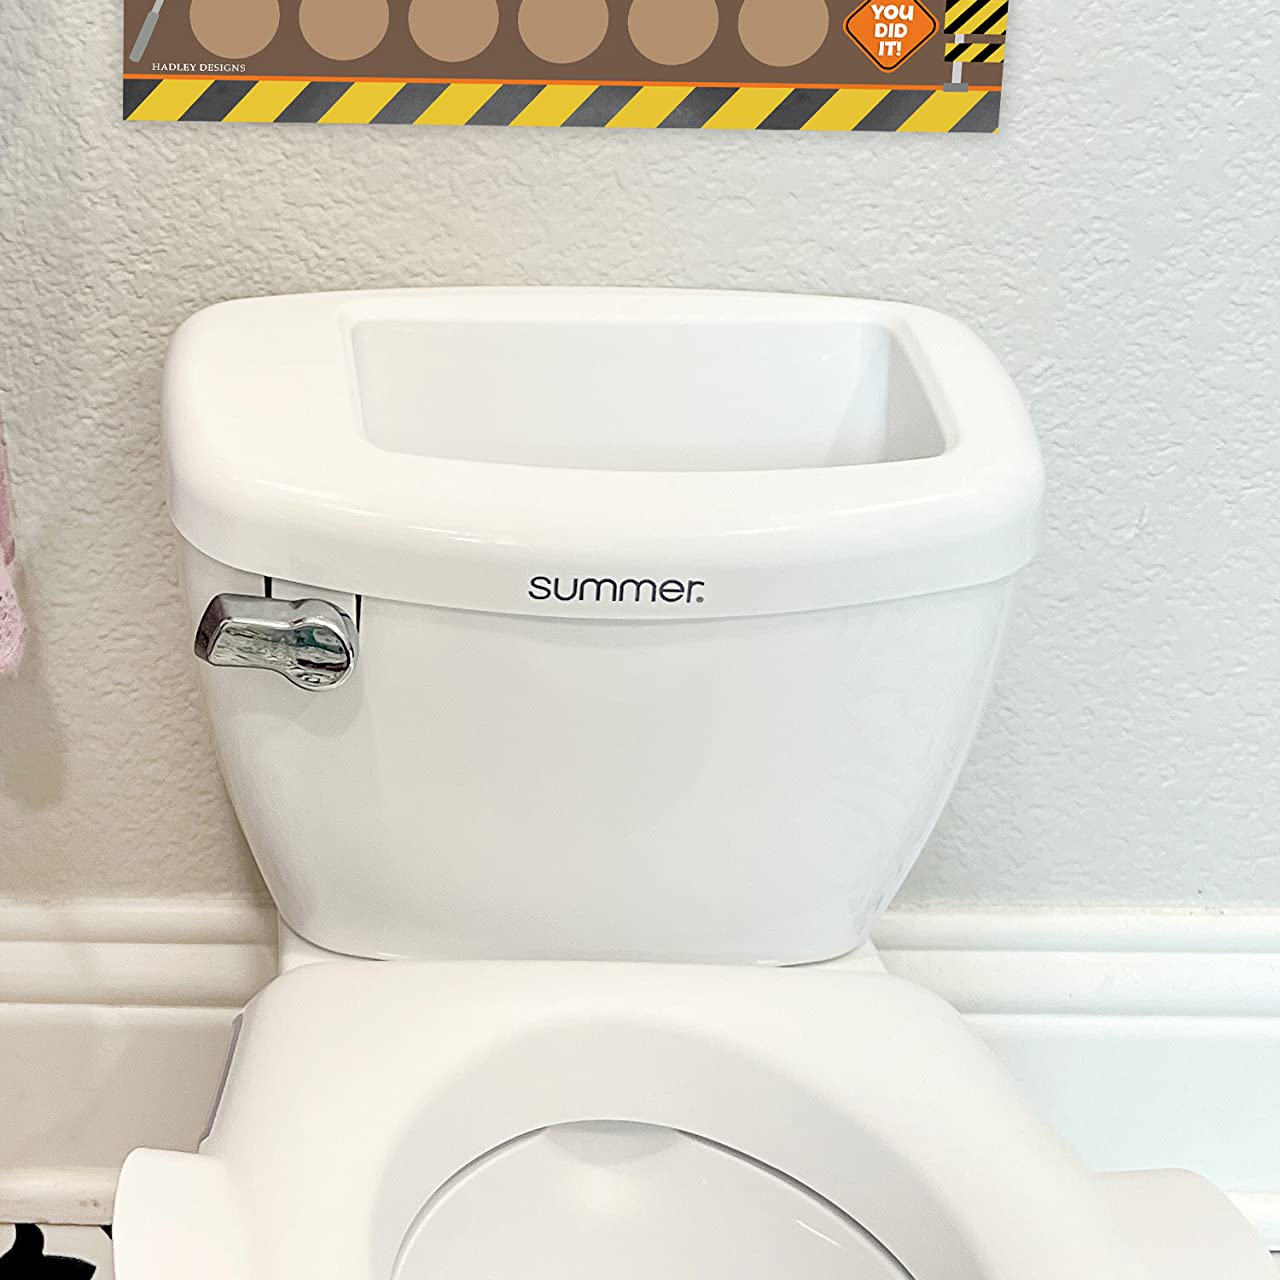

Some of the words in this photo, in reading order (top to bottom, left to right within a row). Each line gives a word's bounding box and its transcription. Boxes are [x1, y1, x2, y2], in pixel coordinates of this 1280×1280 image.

[871, 4, 914, 21] YOU
[874, 23, 908, 38] DID
[878, 41, 902, 57] IT!
[152, 62, 197, 72] HADLEY
[199, 63, 246, 73] DESIGNS
